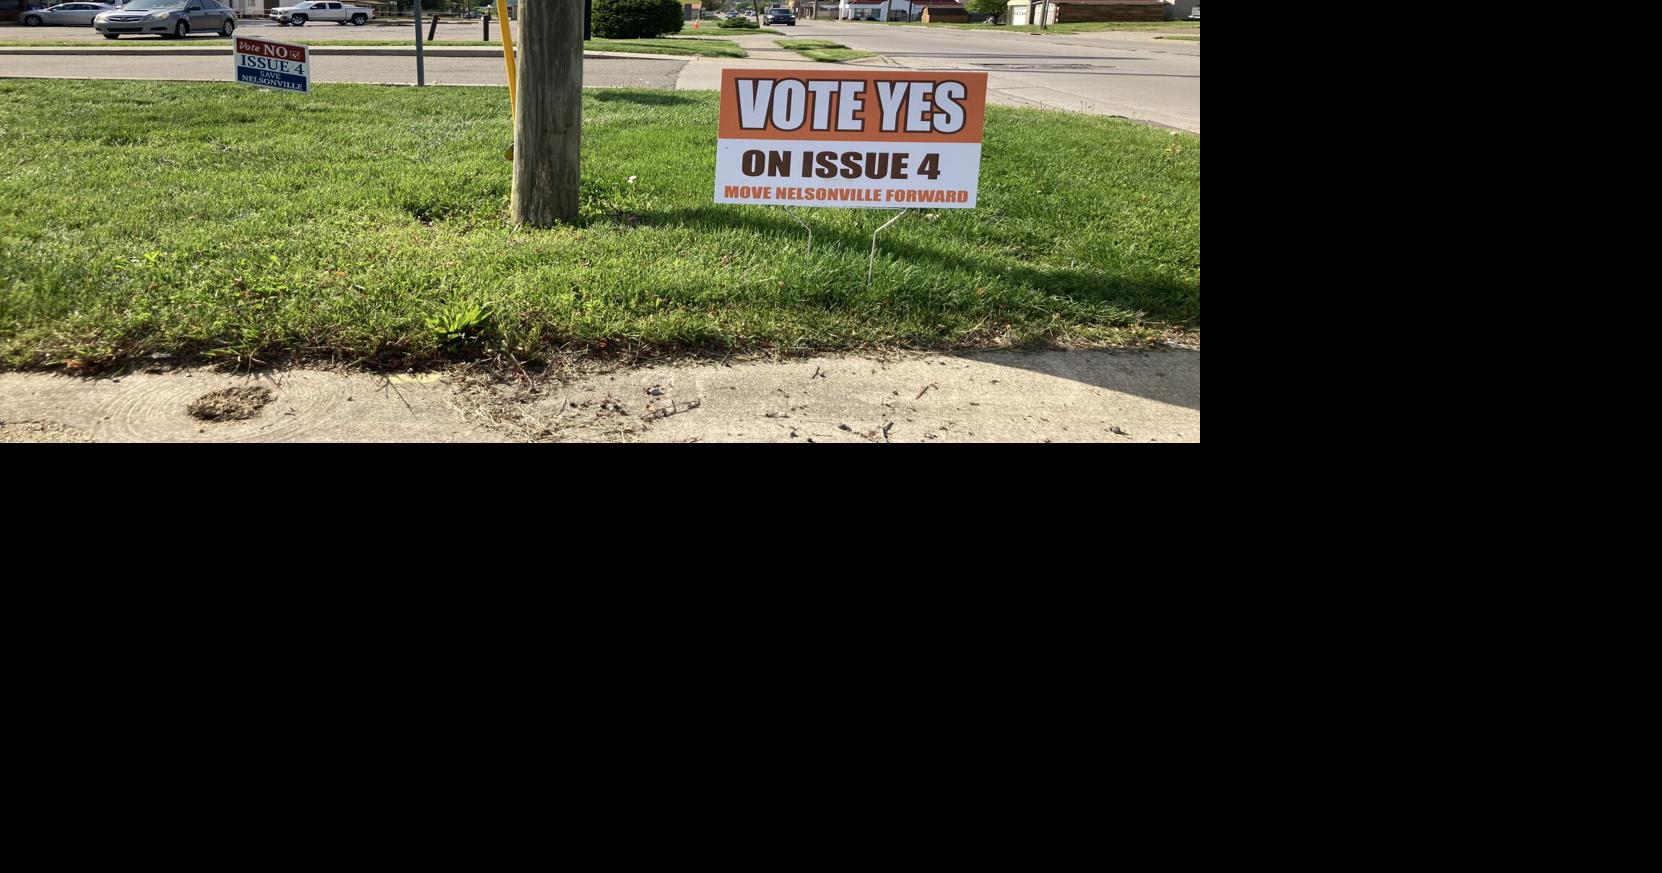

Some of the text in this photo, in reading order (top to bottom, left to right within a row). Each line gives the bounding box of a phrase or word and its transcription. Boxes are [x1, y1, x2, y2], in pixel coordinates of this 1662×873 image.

[240, 41, 288, 58] Vote NO
[241, 54, 304, 75] ISSUE 4
[242, 74, 303, 91] NELSONVILLE
[260, 70, 281, 80] SAVE
[735, 77, 968, 134] VOTE YES
[741, 149, 941, 180] ON ISSUE 4
[724, 185, 969, 204] MOVE NELSONVILLE FORWARD
